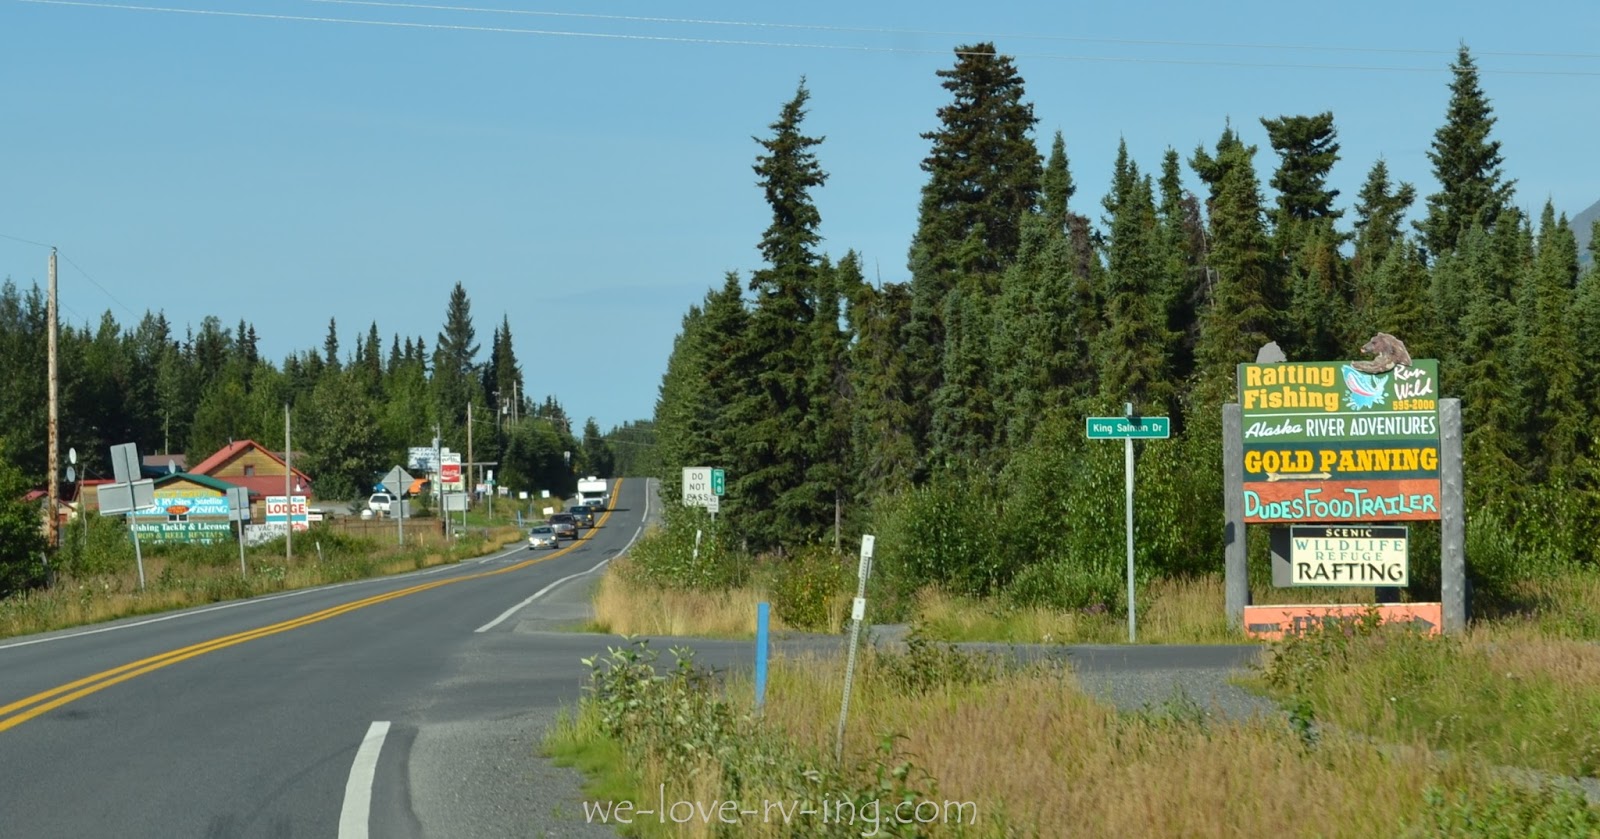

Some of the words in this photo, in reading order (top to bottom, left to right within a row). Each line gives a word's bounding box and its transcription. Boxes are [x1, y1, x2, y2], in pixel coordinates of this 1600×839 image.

[1246, 365, 1335, 387] Rafting
[1394, 365, 1426, 381] Run
[1394, 377, 1433, 400] Wild
[1244, 386, 1339, 411] Fishing
[1392, 399, 1435, 411] 595-2000
[1093, 424, 1113, 434] King
[1152, 423, 1162, 432] Dr
[1244, 418, 1303, 438] Alaska
[1306, 418, 1345, 437] RIVER
[1350, 416, 1436, 436] ADVENTURES
[1244, 449, 1314, 473] GOLD
[1319, 447, 1438, 472] PANNING
[268, 504, 305, 514] LODGE
[130, 524, 160, 532] Fishing
[161, 523, 186, 531] Tackle
[188, 523, 196, 531] &
[198, 522, 230, 531] Licenses
[1325, 529, 1373, 538] SCENIC
[1295, 539, 1404, 552] WILDLIFE
[1315, 551, 1384, 561] REFUGE
[1298, 562, 1404, 581] RAFTING
